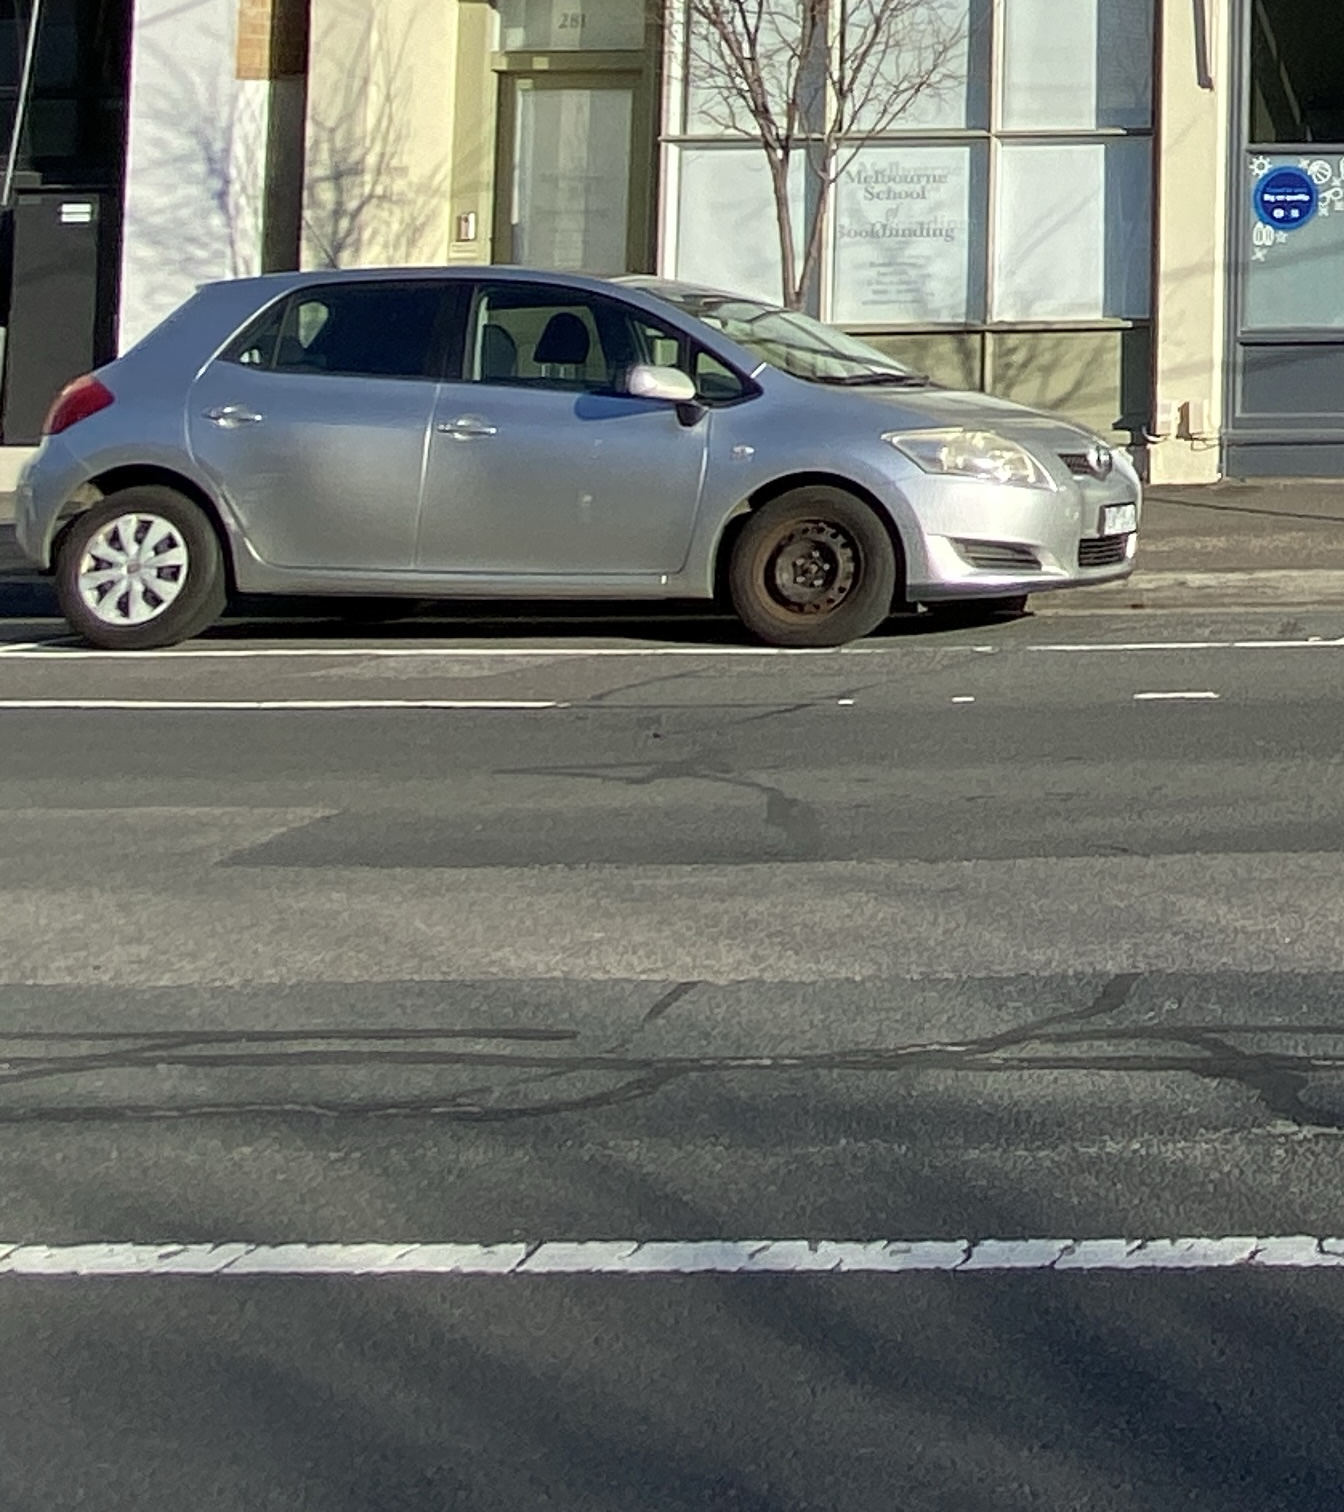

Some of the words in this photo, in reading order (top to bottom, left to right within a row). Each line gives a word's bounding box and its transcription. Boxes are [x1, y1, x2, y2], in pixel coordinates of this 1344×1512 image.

[558, 12, 586, 29] 281
[845, 170, 949, 185] Melbourne
[863, 186, 928, 201] School
